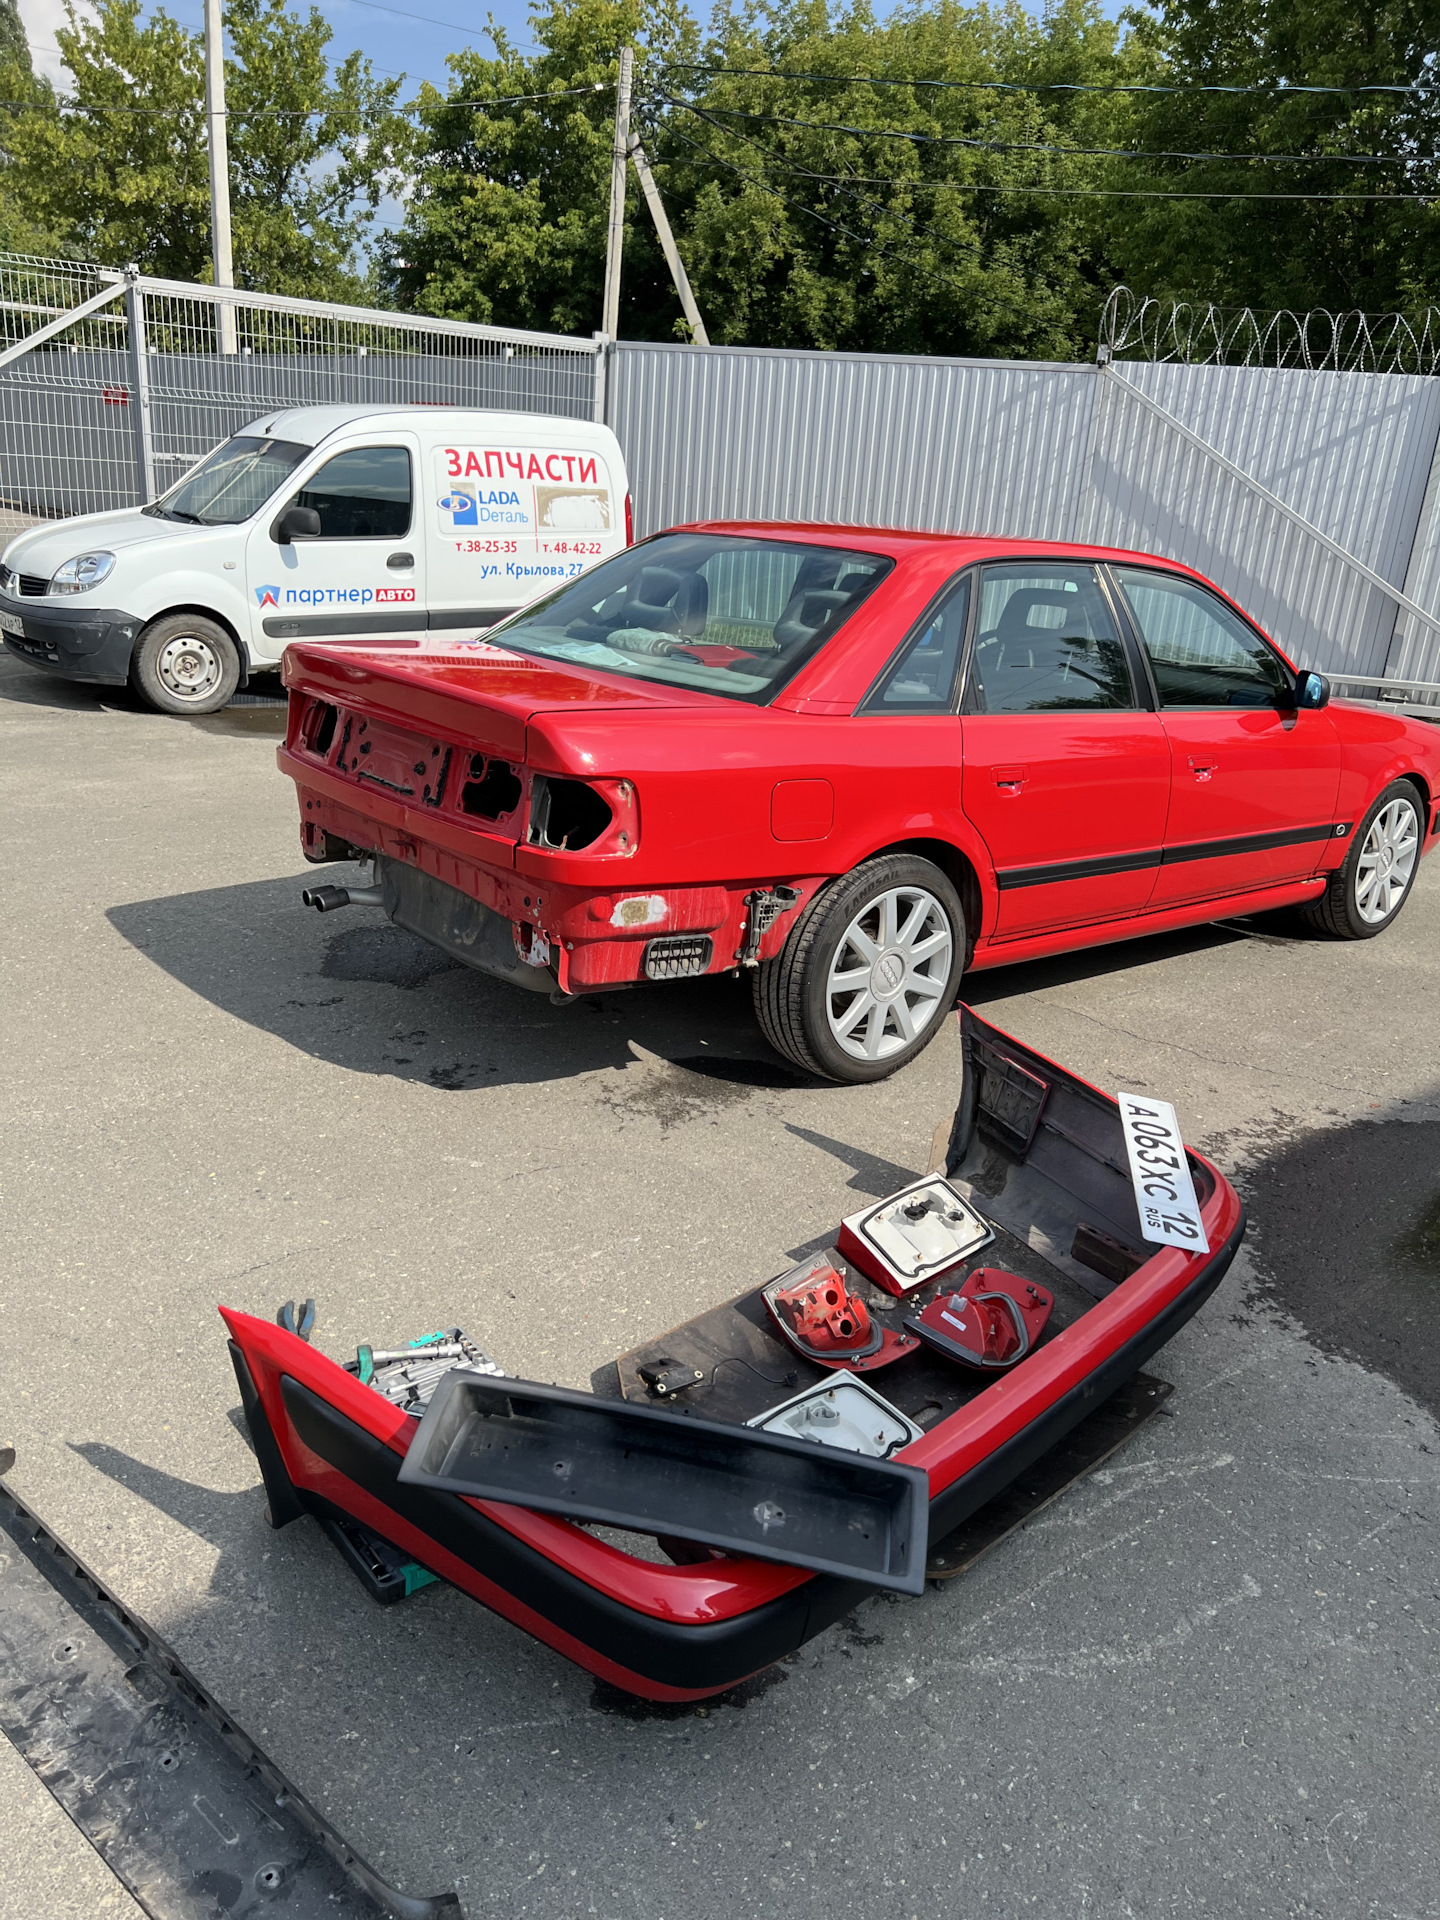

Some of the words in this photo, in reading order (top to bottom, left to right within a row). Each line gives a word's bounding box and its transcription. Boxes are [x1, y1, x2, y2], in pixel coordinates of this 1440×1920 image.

[444, 448, 598, 484] ЗАПЧАСТИ
[478, 490, 520, 505] LADA
[481, 564, 502, 579] ул.
[286, 588, 373, 606] партнер
[377, 589, 414, 602] АВТО
[1144, 1206, 1162, 1229] RUS
[1161, 1212, 1199, 1240] 12
